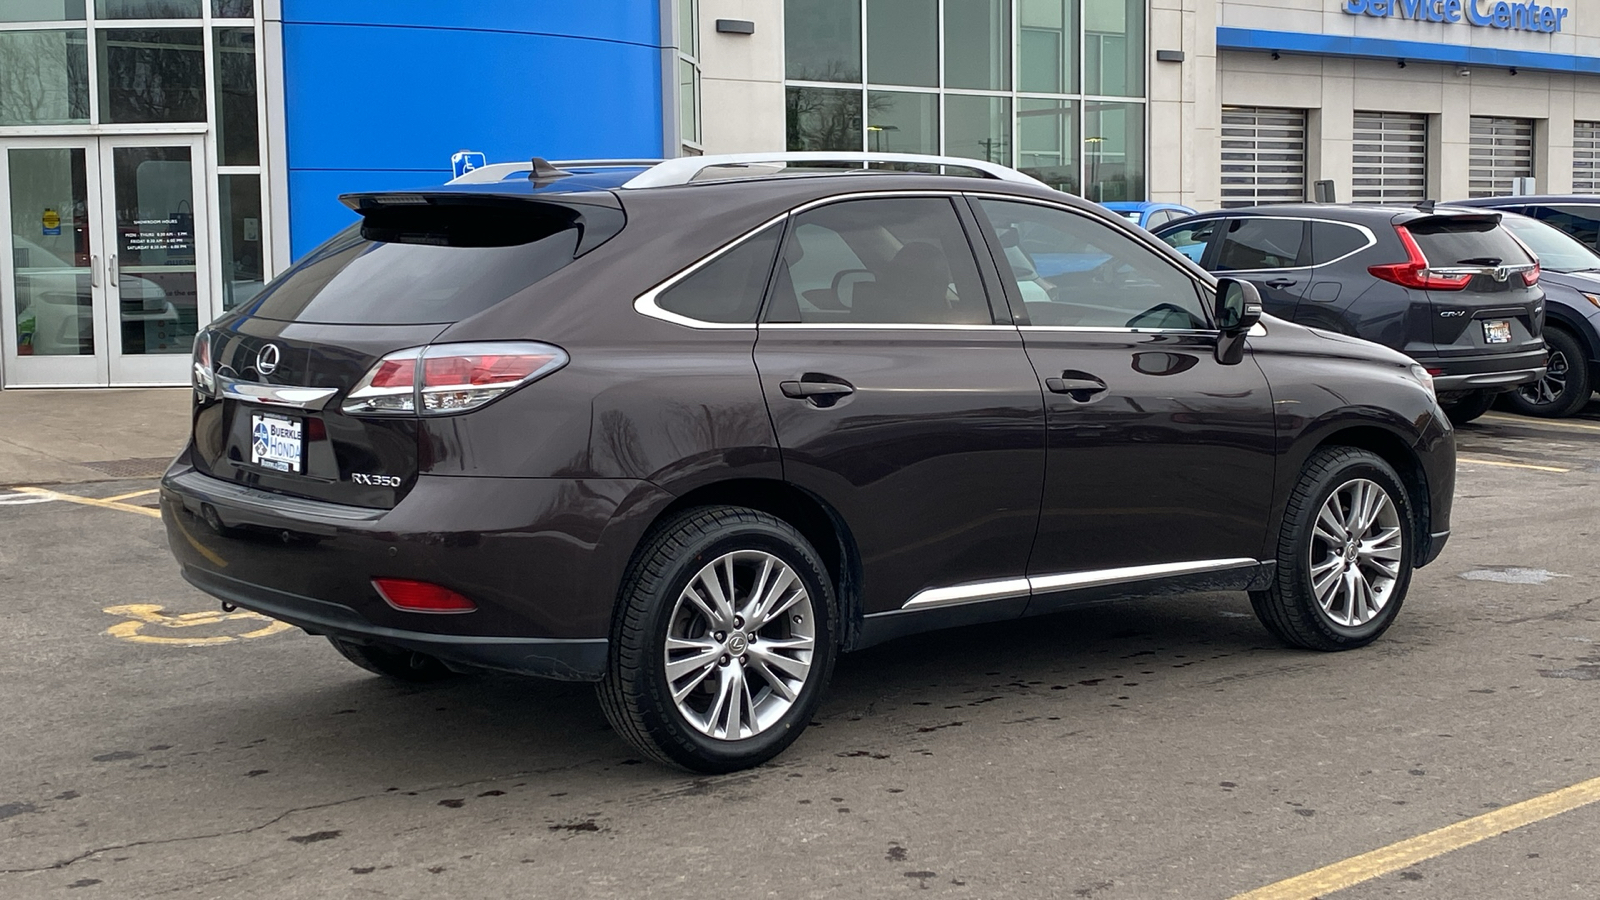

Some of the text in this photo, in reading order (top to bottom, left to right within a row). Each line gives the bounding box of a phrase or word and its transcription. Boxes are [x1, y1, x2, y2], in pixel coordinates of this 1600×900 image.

[1465, 0, 1568, 33] Center
[1440, 310, 1466, 318] CR-V
[270, 424, 301, 440] BUERKLE
[270, 437, 300, 459] HONDA
